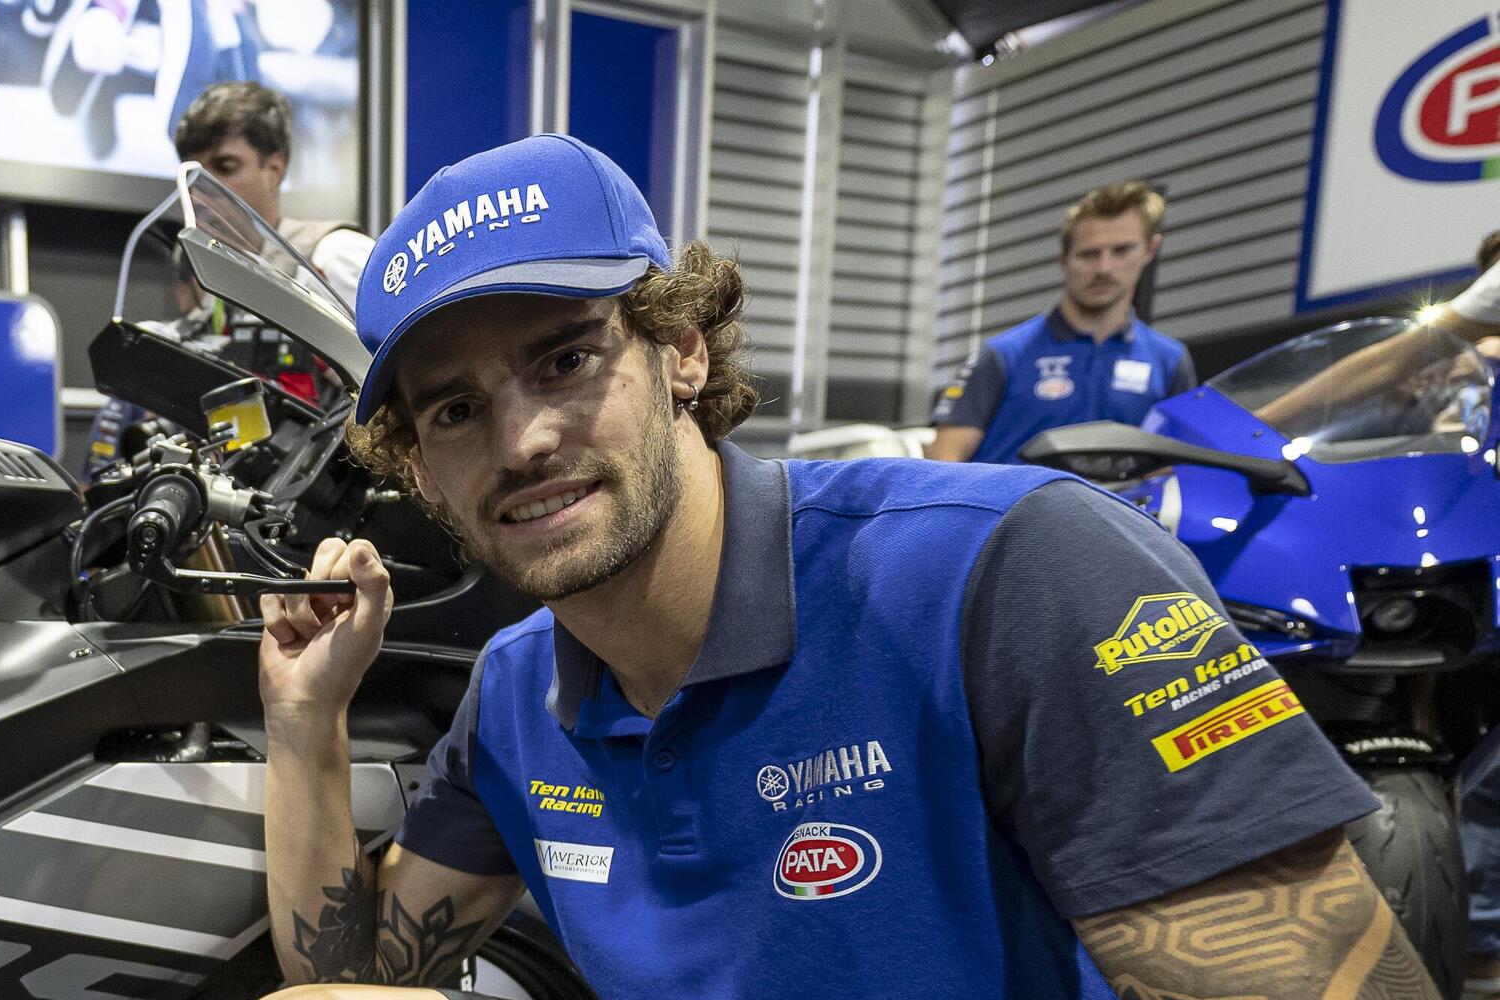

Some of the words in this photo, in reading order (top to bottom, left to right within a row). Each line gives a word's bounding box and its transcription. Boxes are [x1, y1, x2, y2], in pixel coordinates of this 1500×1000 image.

[407, 183, 550, 262] YAMAHA
[1097, 598, 1222, 671] Putolin
[1123, 677, 1190, 718] Ten
[1169, 679, 1222, 711] RACING
[1172, 680, 1302, 761] PIRELL
[1344, 736, 1434, 755] YAMAHA
[787, 740, 893, 794] YAMAHA
[530, 780, 570, 798] Ten
[772, 778, 885, 812] RACING
[539, 797, 603, 818] Racing
[794, 825, 828, 840] SNACK
[537, 843, 609, 871] MAVERICK
